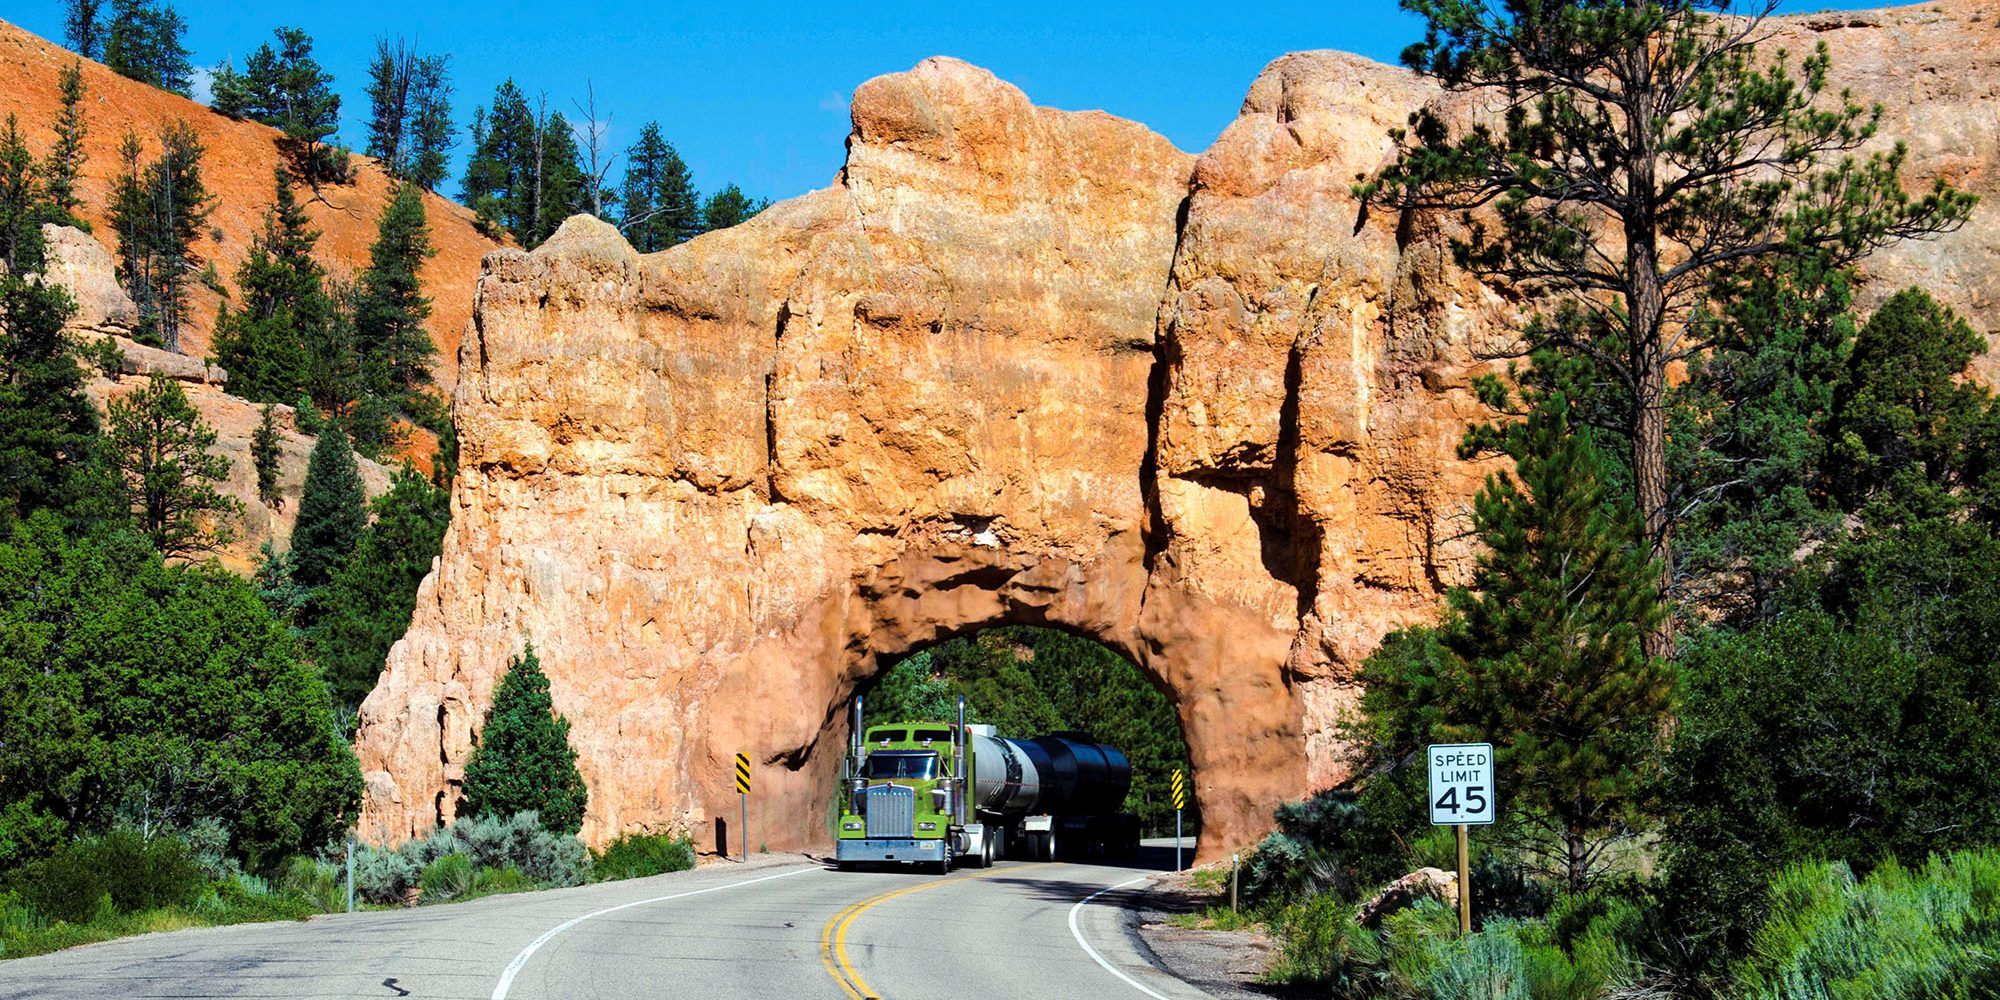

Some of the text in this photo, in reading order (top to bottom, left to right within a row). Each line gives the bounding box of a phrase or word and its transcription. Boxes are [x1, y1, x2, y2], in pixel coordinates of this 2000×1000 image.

[1435, 754, 1487, 767] SPEED
[1441, 770, 1481, 782] LIMIT
[1435, 786, 1487, 814] 45
